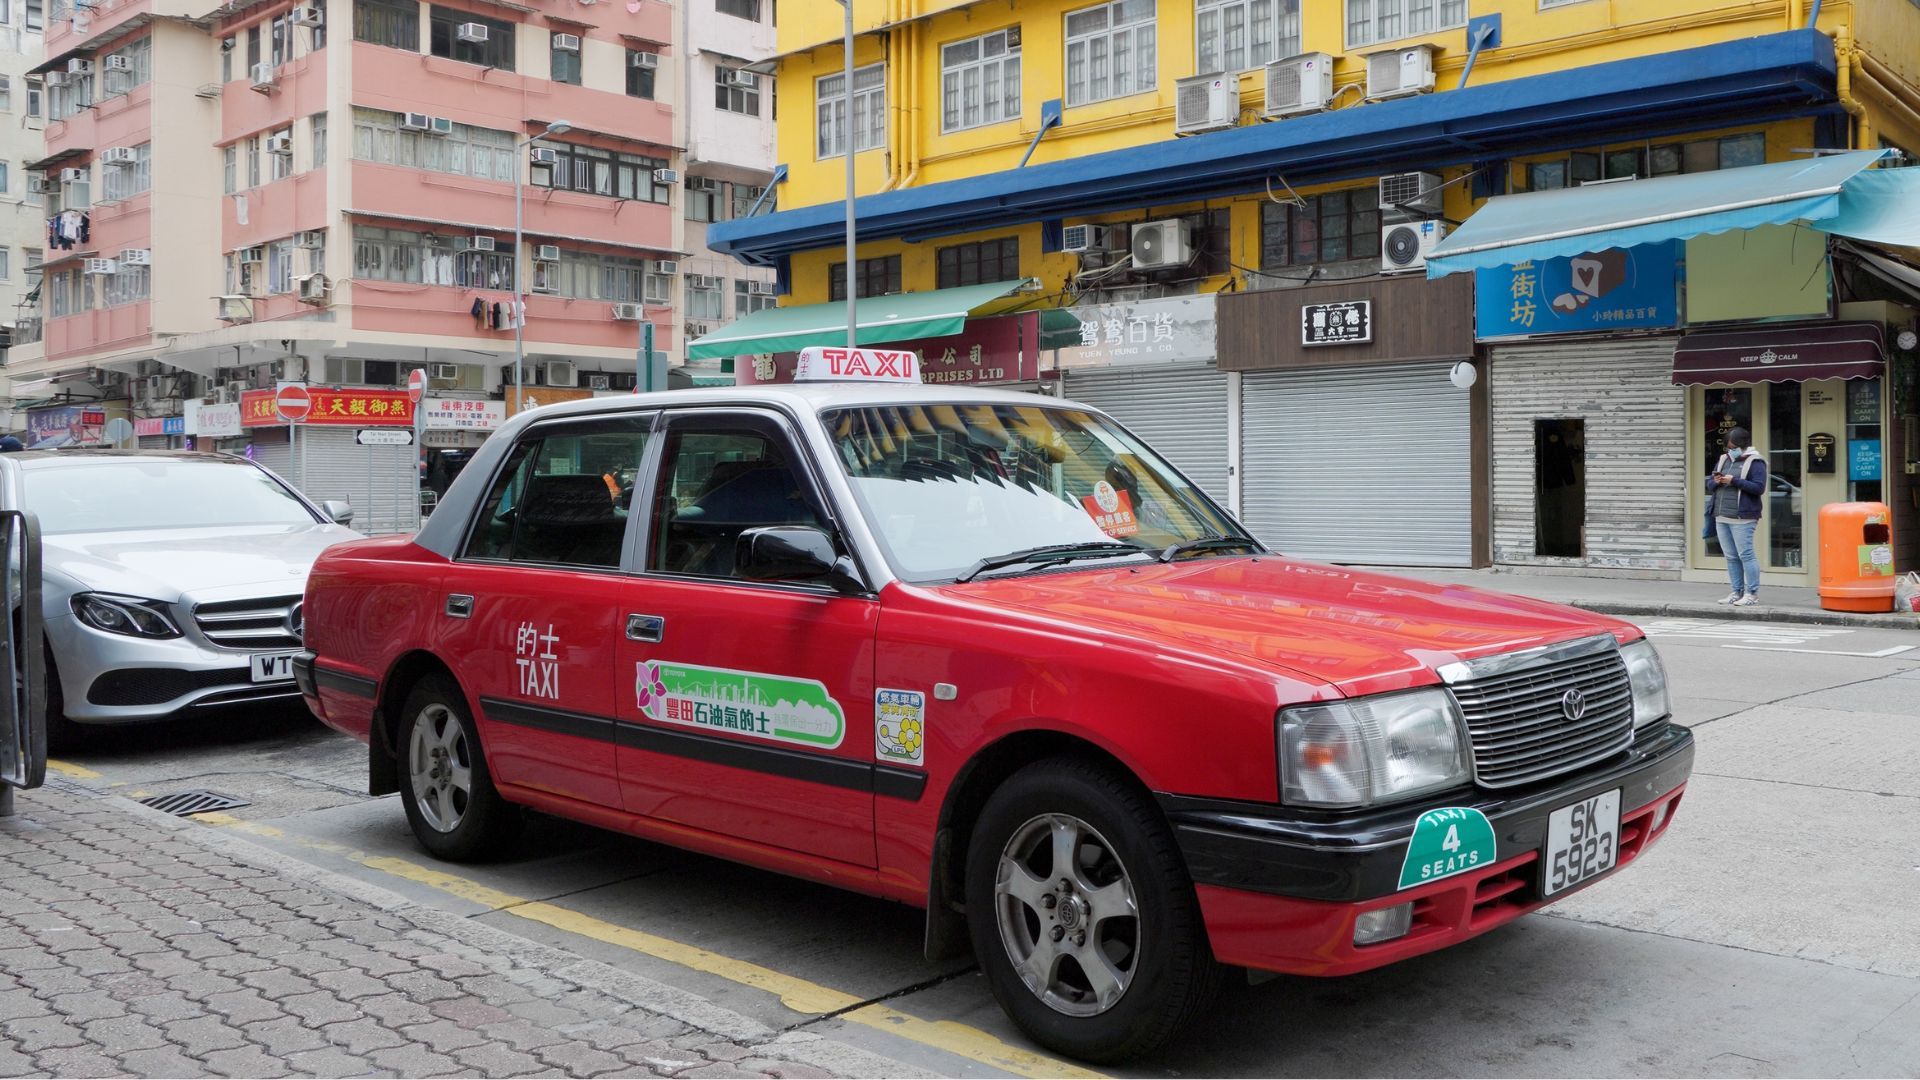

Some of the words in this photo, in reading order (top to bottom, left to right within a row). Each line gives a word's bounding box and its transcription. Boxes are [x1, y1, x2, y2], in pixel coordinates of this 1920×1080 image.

[1079, 312, 1174, 347] 鴛鴦百貨
[800, 353, 810, 375] 的士
[823, 350, 912, 378] TAXI
[1079, 350, 1102, 358] YUEN
[1159, 343, 1175, 352] CO.
[979, 367, 1004, 379] LTD
[516, 621, 560, 660] 的士
[515, 658, 559, 699] TAXI
[666, 698, 770, 734] 豐田石油氣的士
[1424, 808, 1467, 828] TAXI
[1570, 798, 1600, 844] SK
[1442, 824, 1461, 853] 4
[1421, 850, 1479, 879] SEATS
[1551, 831, 1612, 891] 5923
